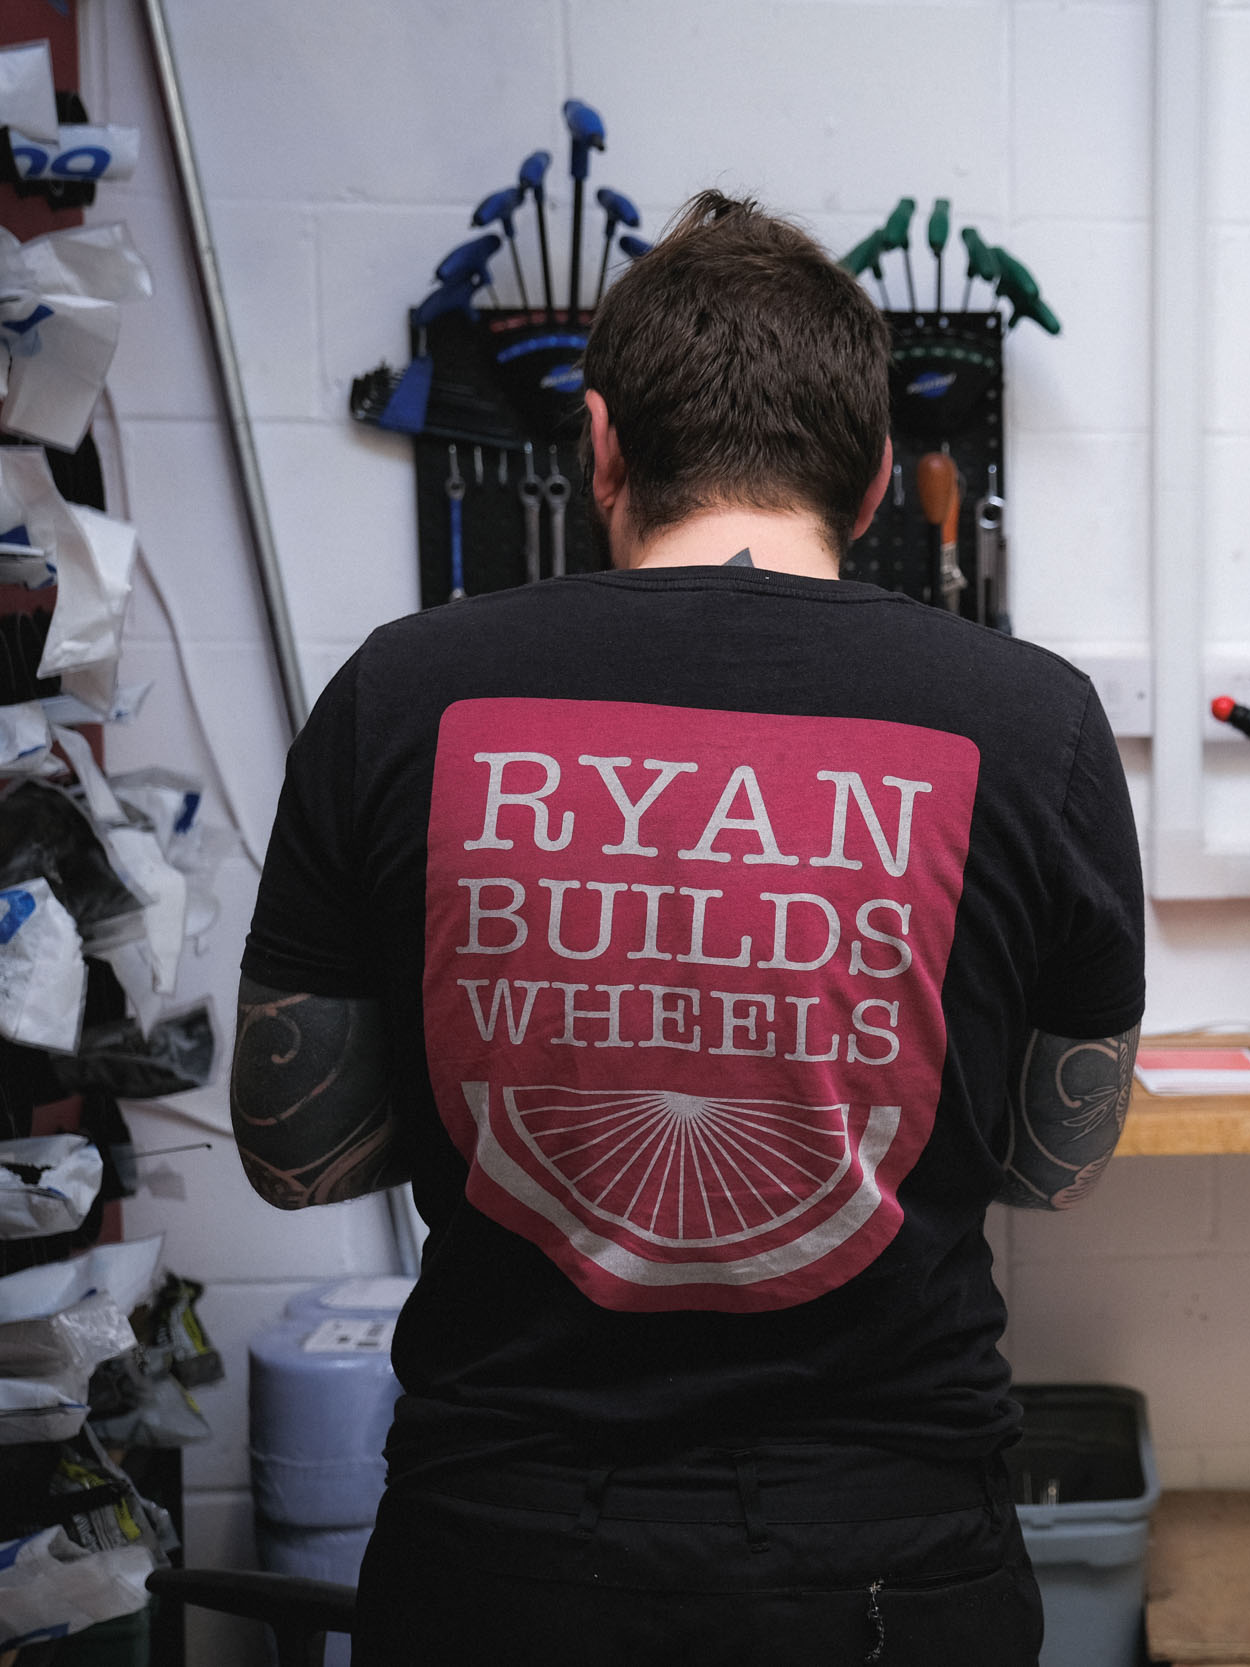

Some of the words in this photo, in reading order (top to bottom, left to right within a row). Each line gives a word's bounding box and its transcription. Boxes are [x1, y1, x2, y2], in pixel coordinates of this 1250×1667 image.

[463, 751, 933, 878] RYAN
[455, 877, 913, 979] BUILDS
[456, 977, 901, 1066] WHEELS
